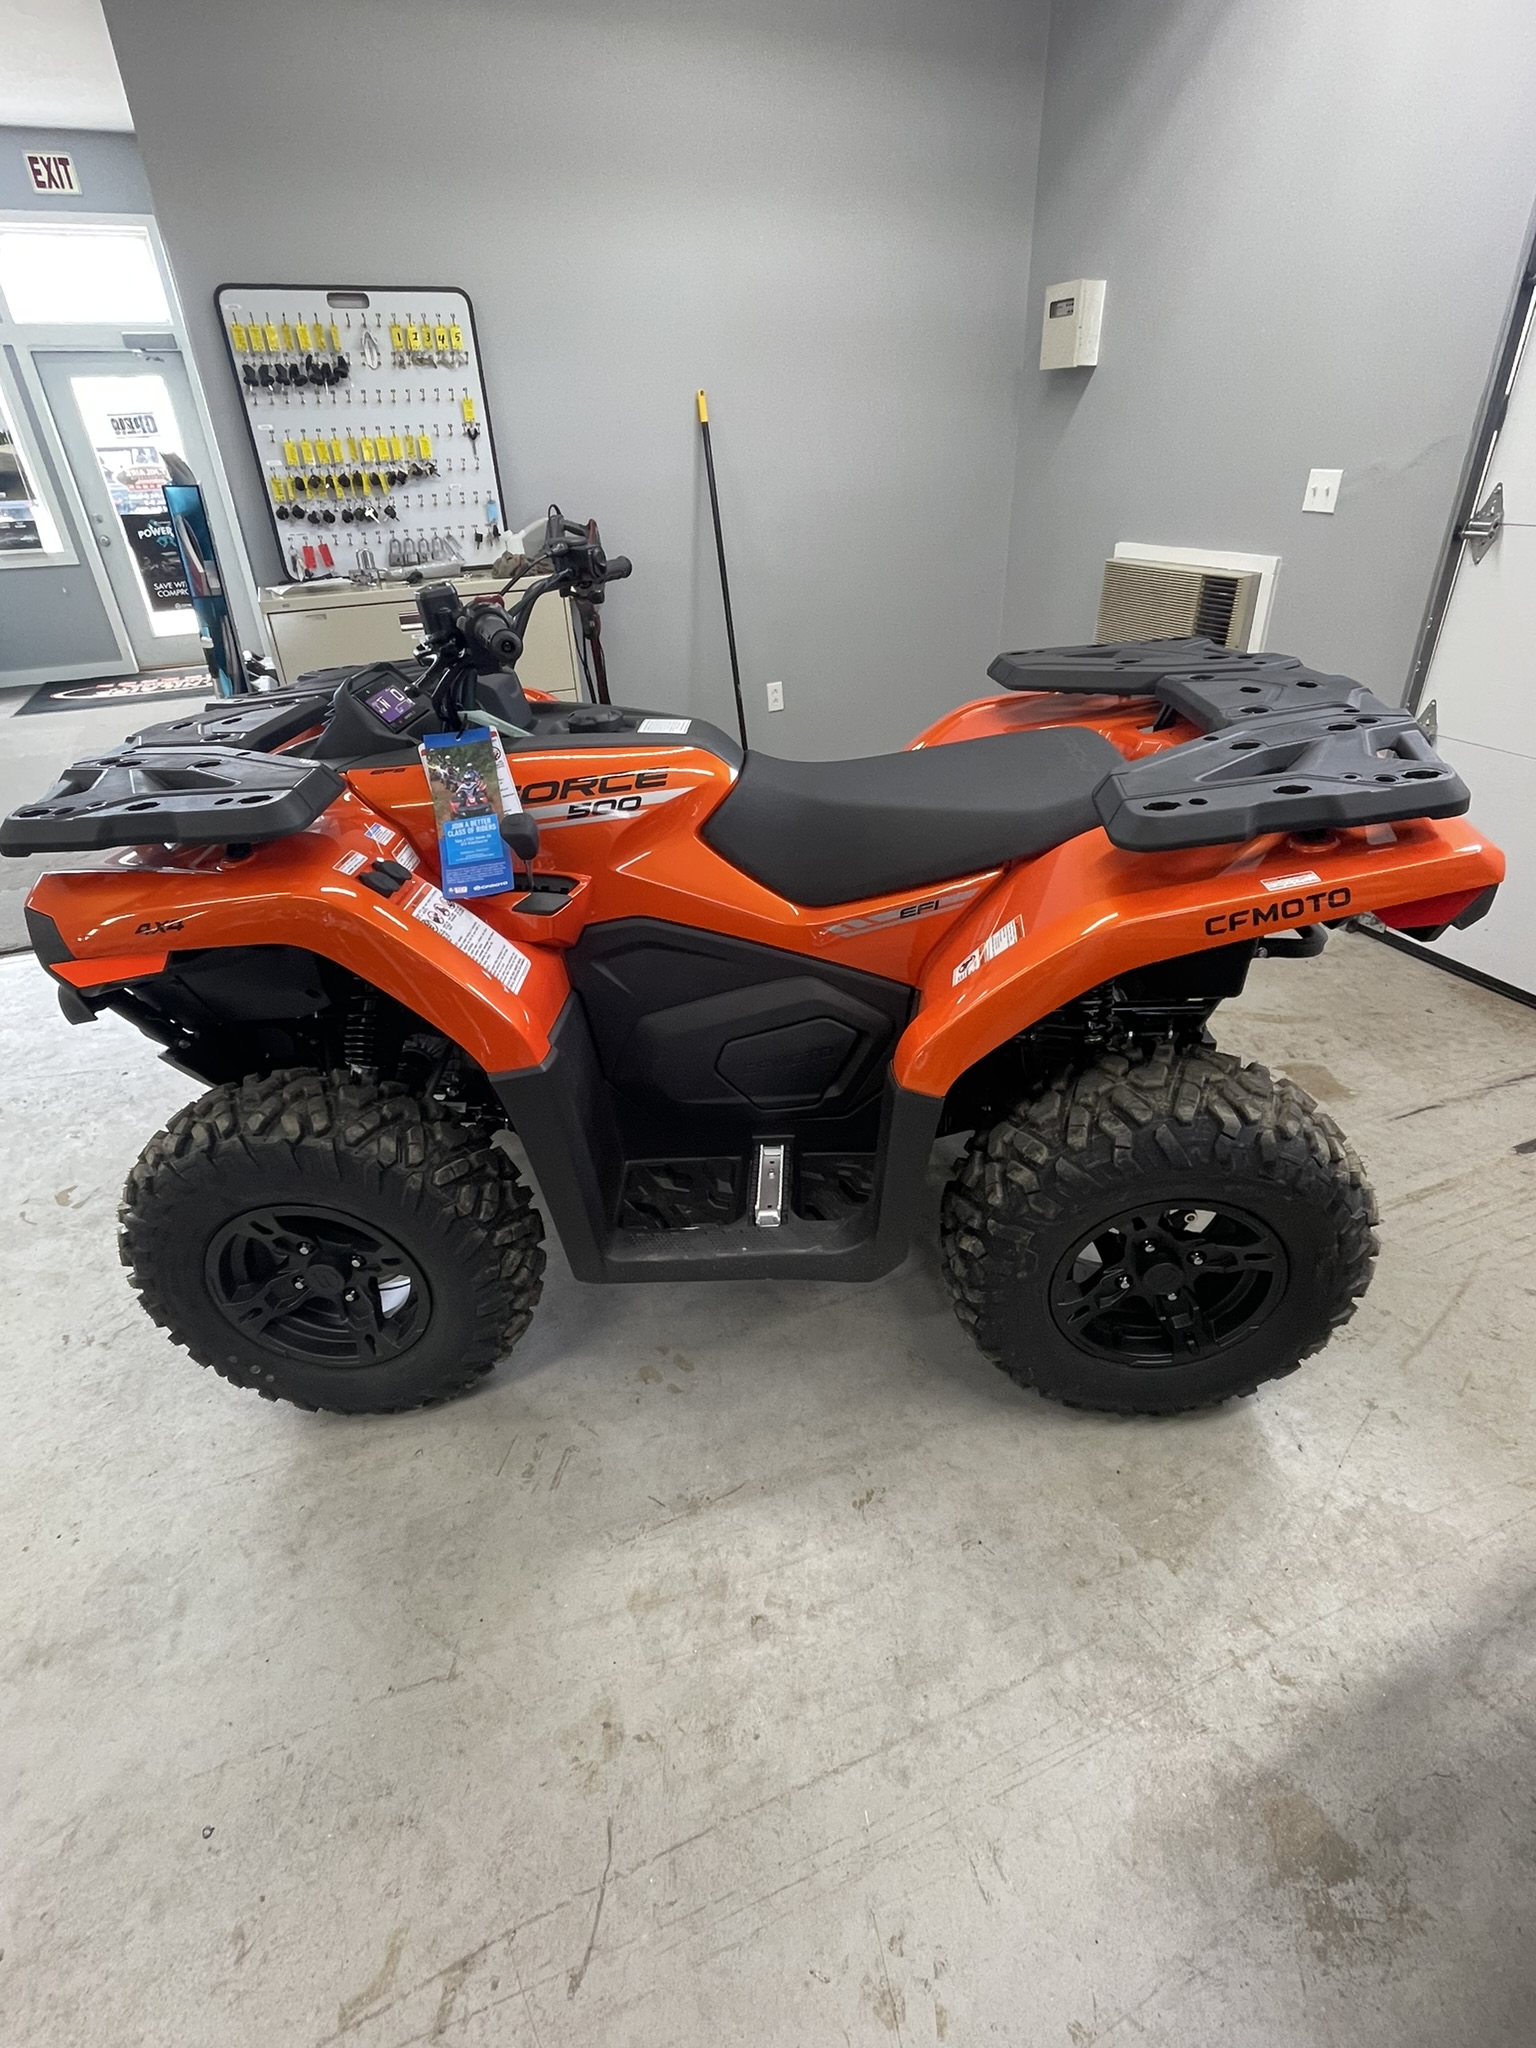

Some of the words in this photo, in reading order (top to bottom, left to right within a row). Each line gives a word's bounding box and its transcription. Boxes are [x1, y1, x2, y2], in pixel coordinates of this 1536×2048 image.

[27, 156, 74, 189] EXIT
[153, 581, 173, 591] SAVE
[567, 795, 642, 820] 500
[447, 828, 467, 838] CLASS
[467, 826, 475, 834] OF
[476, 823, 497, 833] RIDERS
[900, 899, 939, 919] EFI
[1205, 887, 1351, 936] CFMOTO
